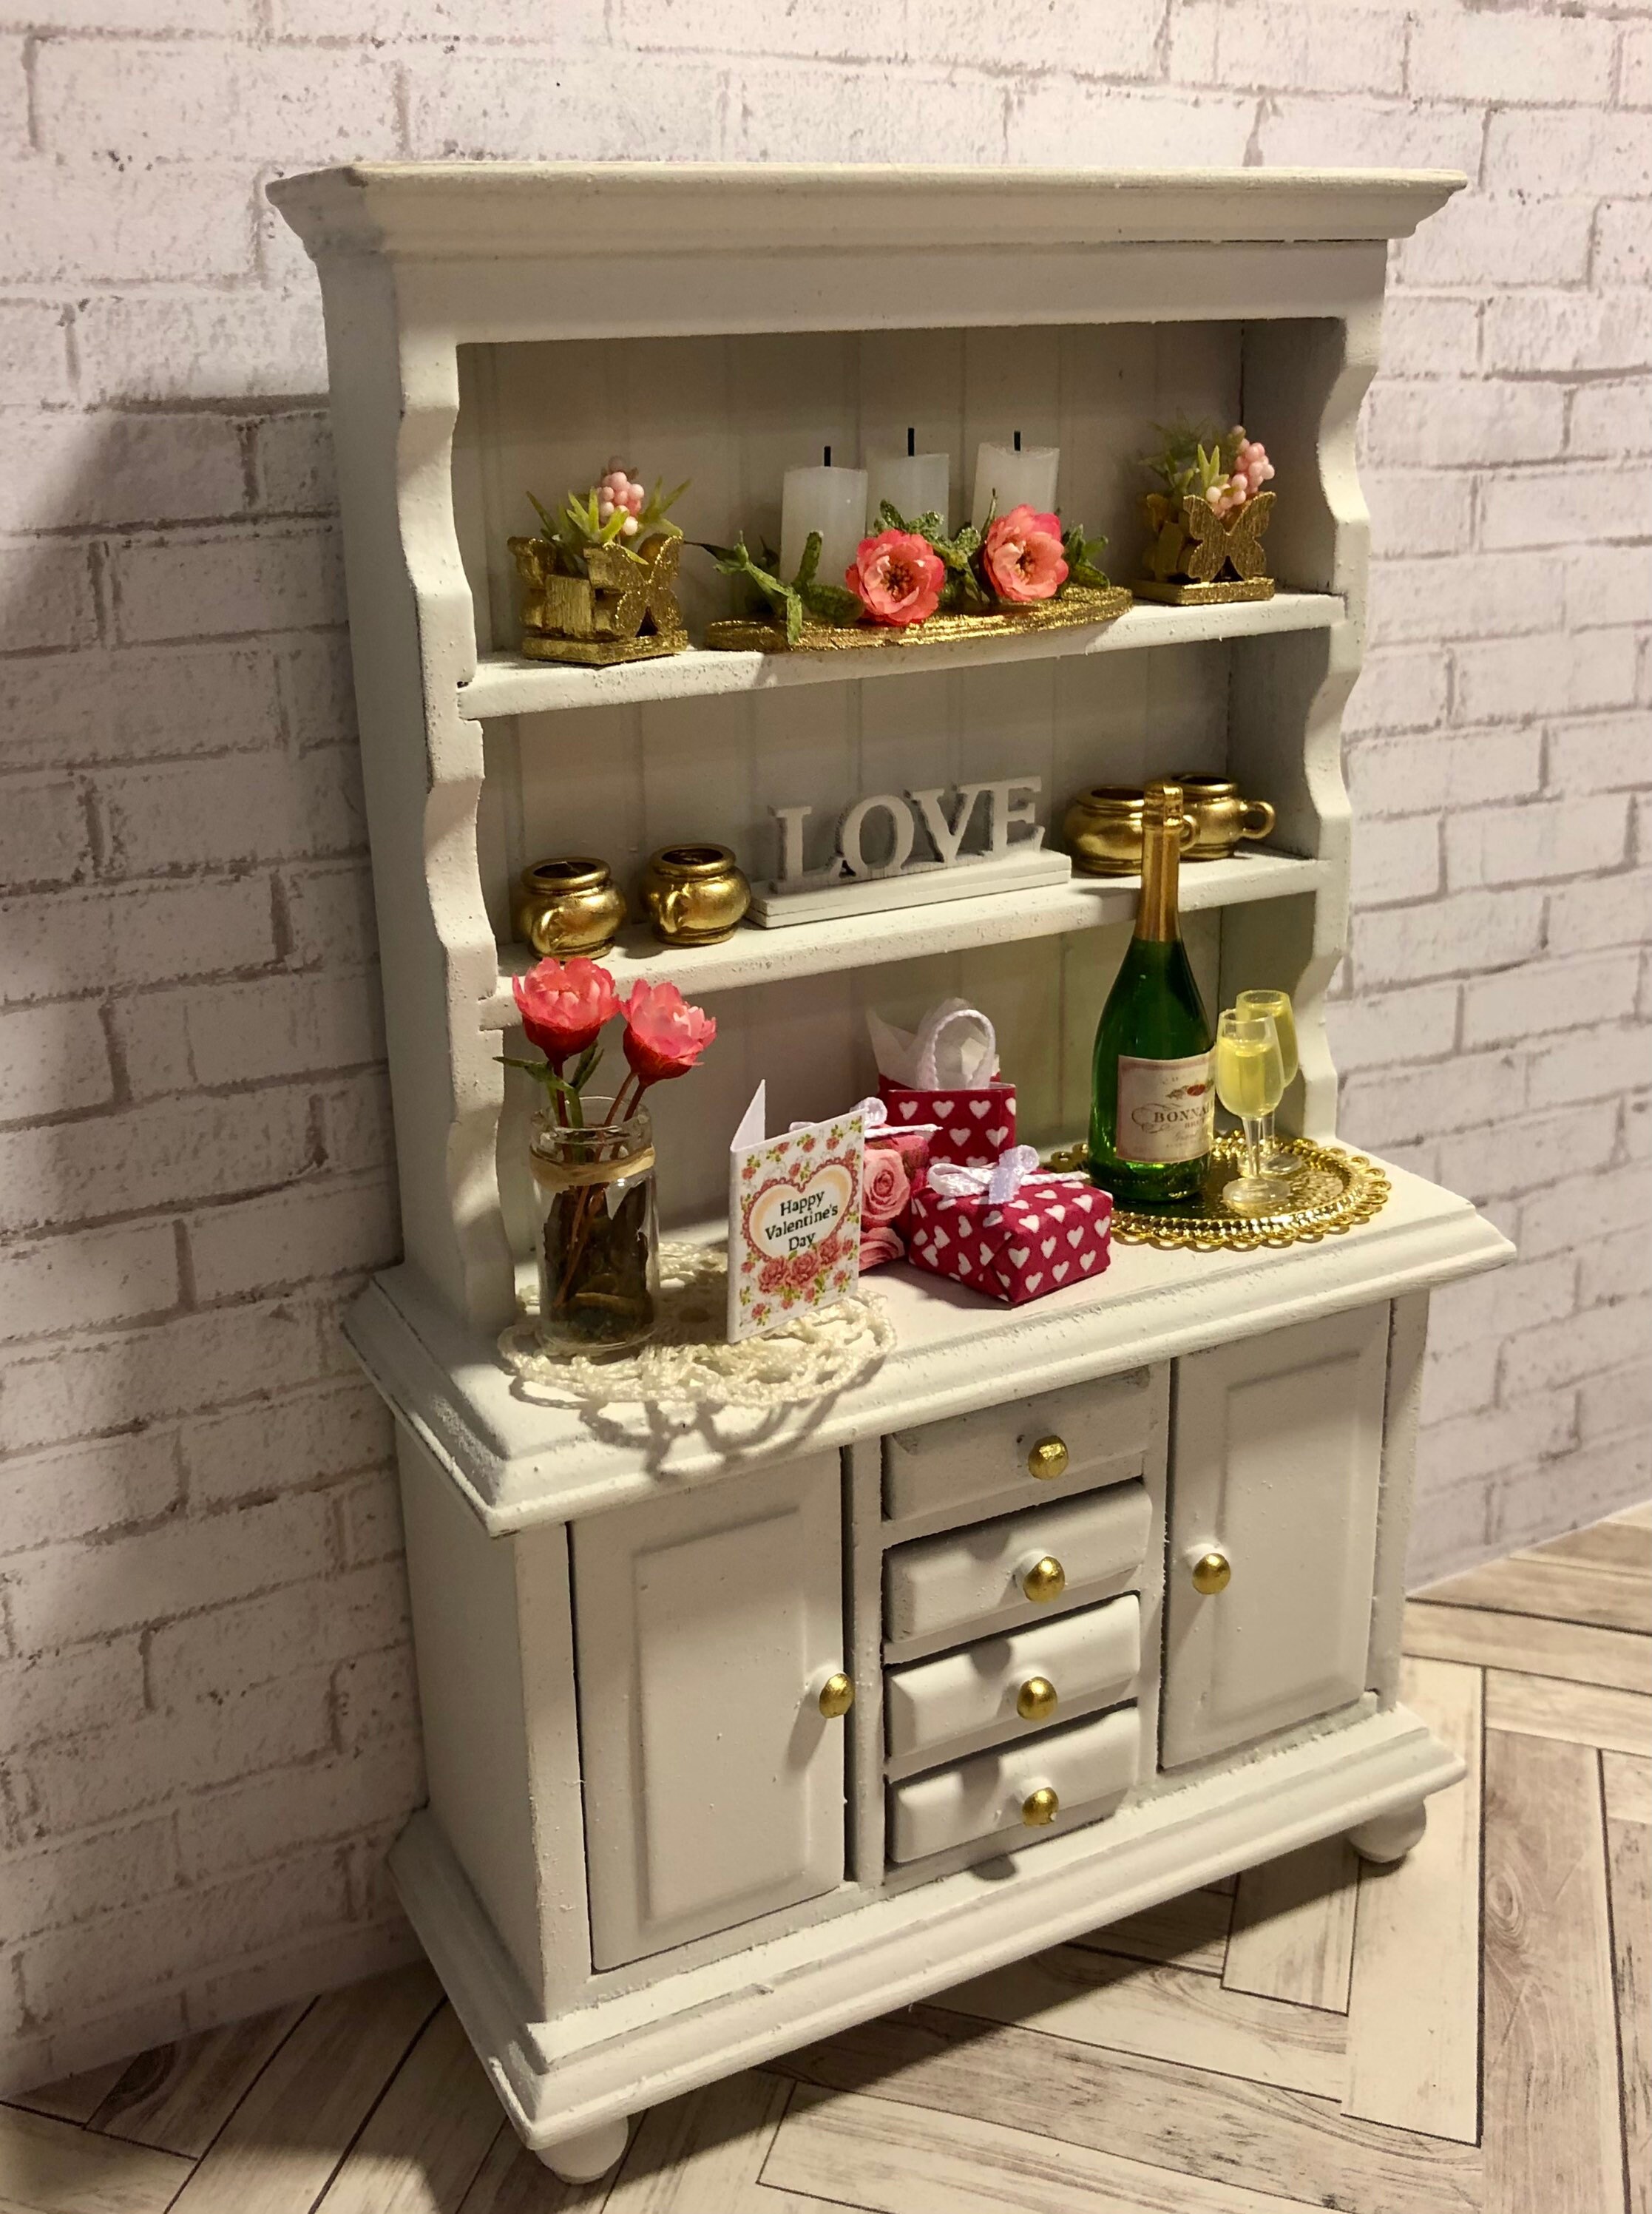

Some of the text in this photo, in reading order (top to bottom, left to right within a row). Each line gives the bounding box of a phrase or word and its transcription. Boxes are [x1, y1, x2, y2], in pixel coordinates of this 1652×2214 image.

[770, 776, 1045, 892] LOVE
[780, 1191, 825, 1216] Happy
[765, 1204, 839, 1241] Valentine's
[788, 1233, 816, 1251] Day
